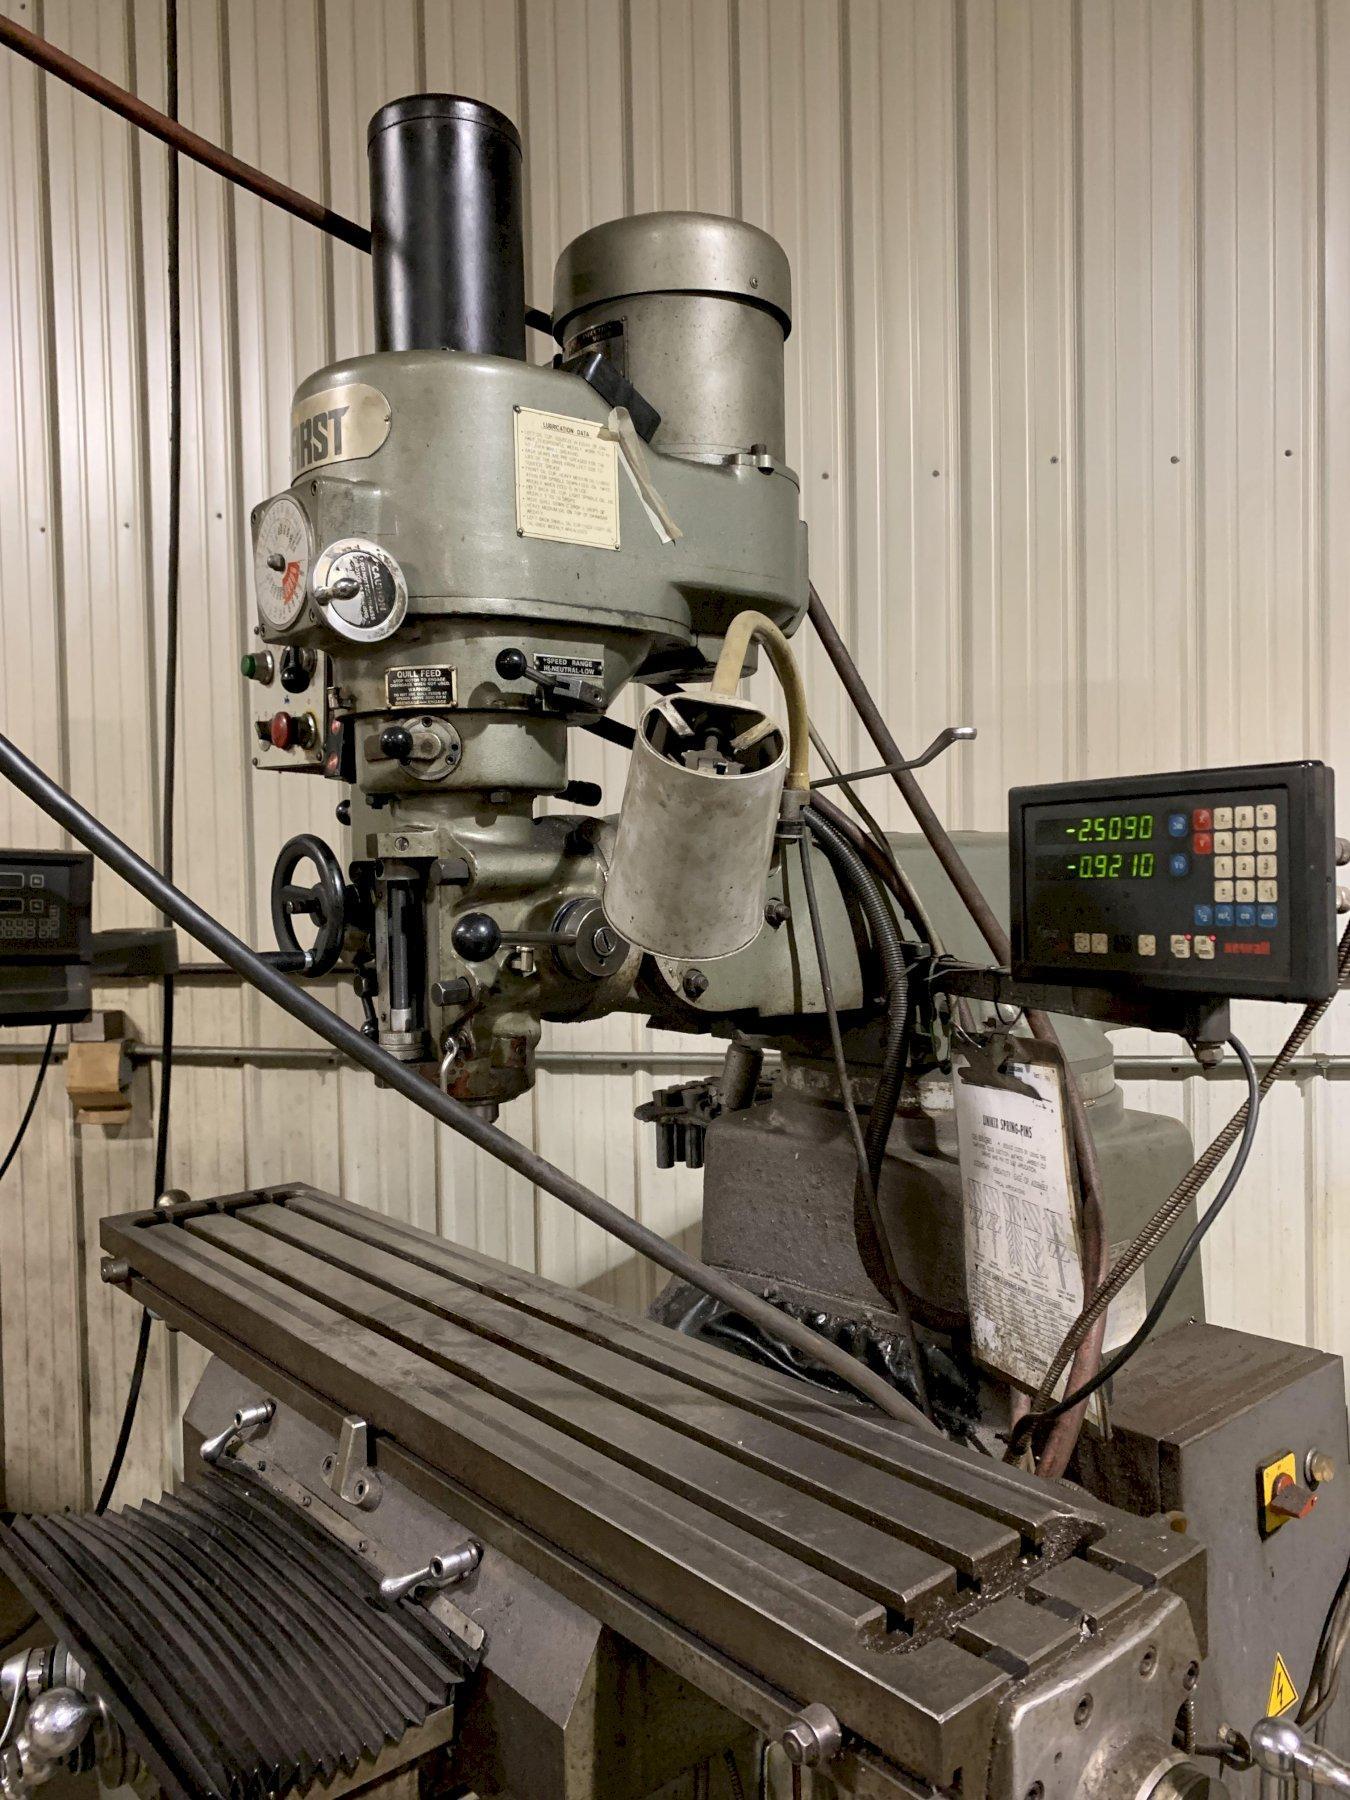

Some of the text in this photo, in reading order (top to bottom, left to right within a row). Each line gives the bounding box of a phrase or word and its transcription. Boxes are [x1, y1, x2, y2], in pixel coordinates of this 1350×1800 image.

[543, 423, 590, 437] LUBRICATION DATA
[371, 564, 387, 611] CAUTION
[546, 657, 593, 668] SPEED RANGE
[397, 669, 442, 678] QUILL FEED
[1000, 1118, 1033, 1139] SPRING-PINS
